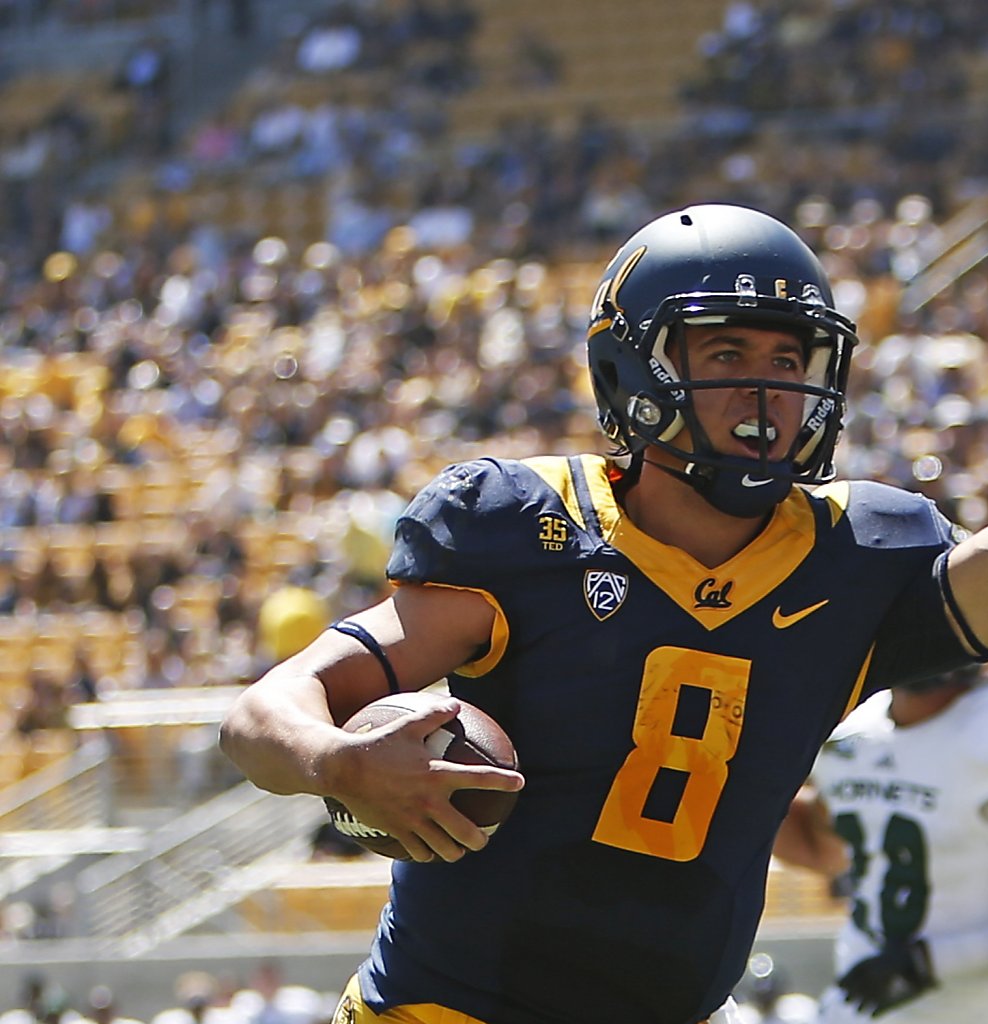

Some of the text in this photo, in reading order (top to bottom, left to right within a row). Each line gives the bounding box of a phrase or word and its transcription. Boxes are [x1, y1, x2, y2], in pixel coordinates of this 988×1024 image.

[539, 516, 567, 542] 35
[541, 540, 563, 551] TED
[587, 571, 626, 603] PAC
[593, 591, 614, 610] 12
[694, 577, 733, 608] Cal
[591, 645, 752, 862] 8
